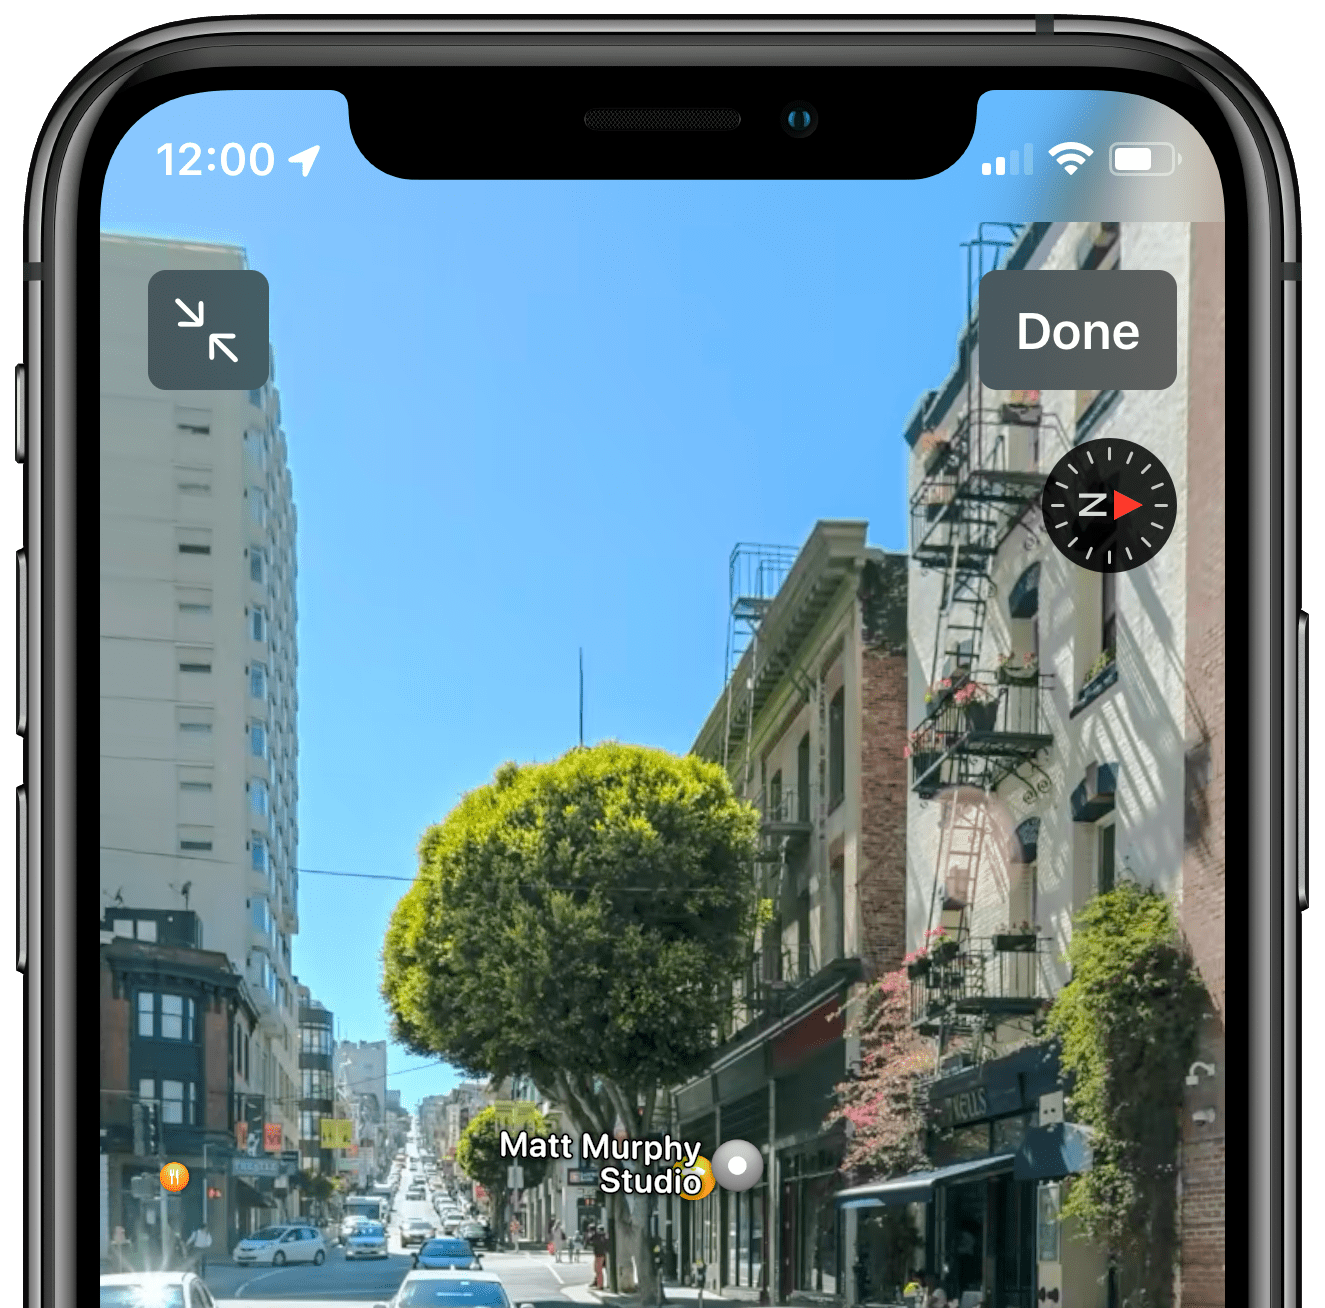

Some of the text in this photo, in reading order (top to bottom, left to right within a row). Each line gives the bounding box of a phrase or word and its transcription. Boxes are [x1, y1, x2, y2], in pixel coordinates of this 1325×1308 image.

[157, 142, 275, 177] 12:00
[1018, 312, 1140, 351] Done
[500, 1131, 701, 1167] Matt Murphy
[600, 1167, 702, 1194] Studio
